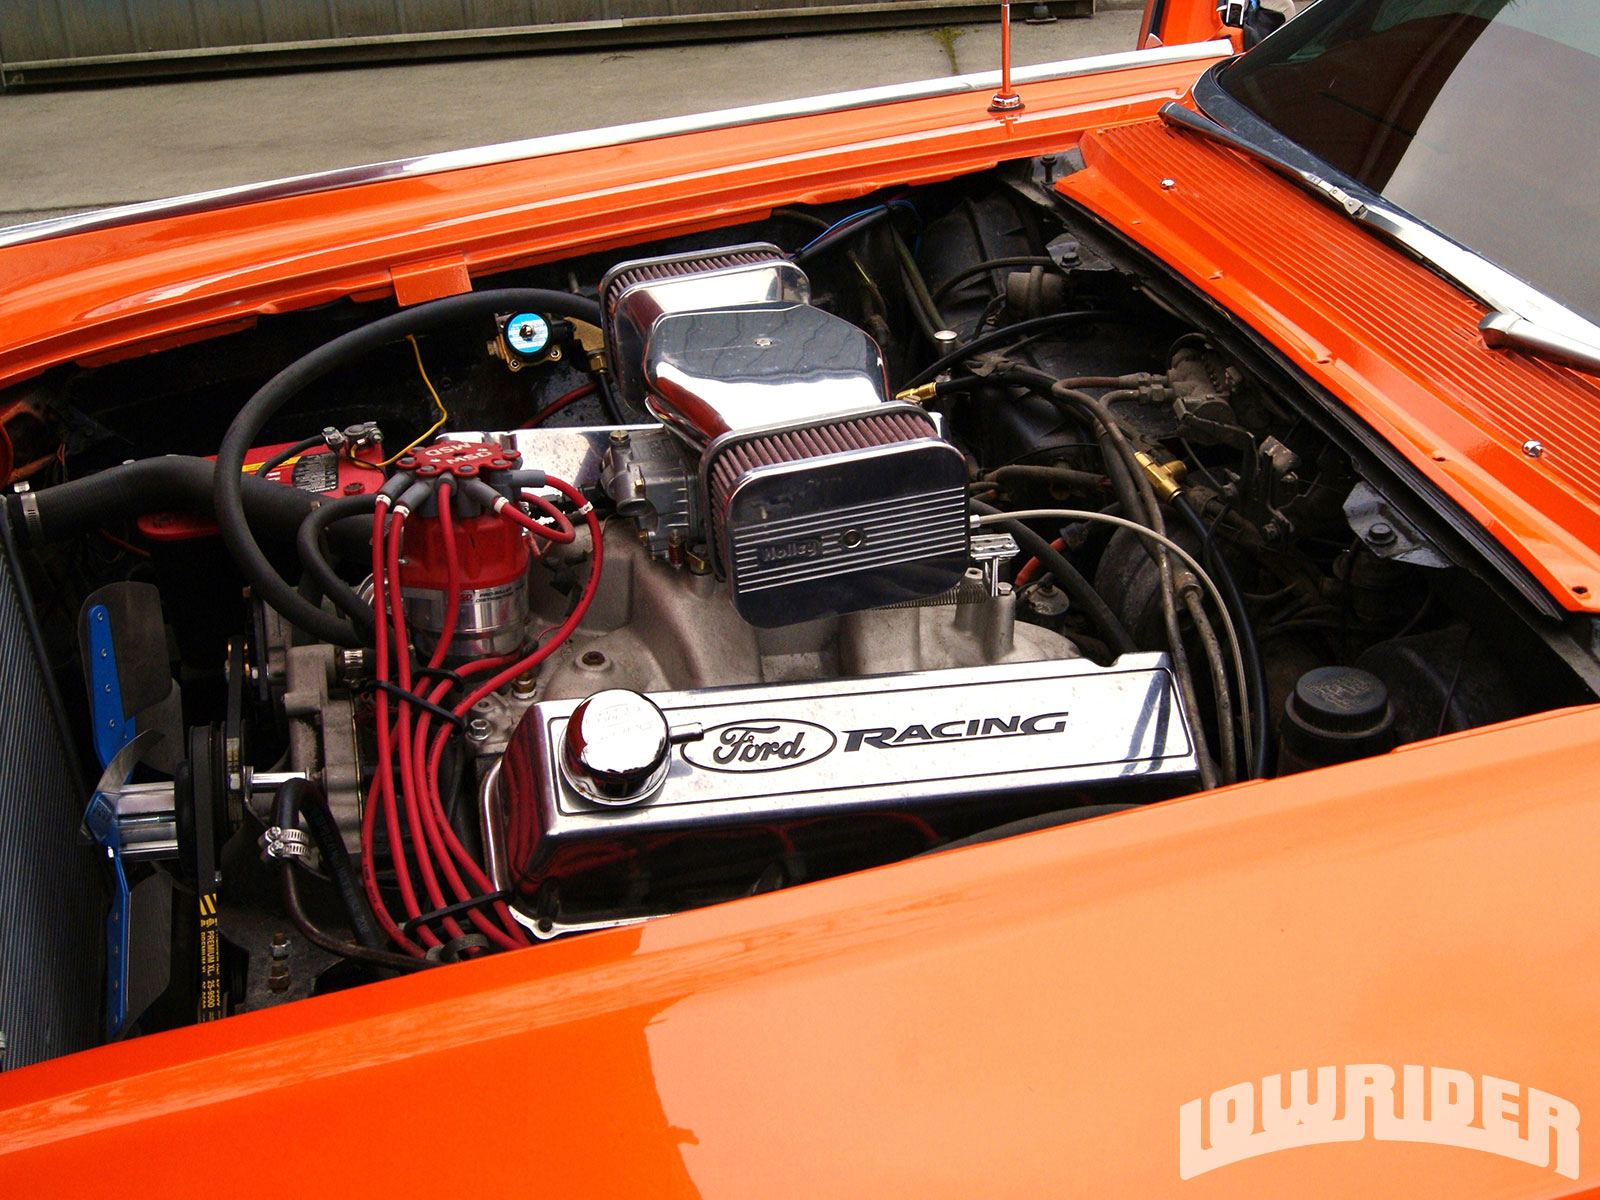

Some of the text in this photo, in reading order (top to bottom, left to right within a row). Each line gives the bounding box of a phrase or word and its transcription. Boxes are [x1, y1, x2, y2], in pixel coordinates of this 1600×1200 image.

[425, 443, 471, 456] MSD
[445, 451, 493, 464] MSD
[713, 711, 1069, 764] Ford RACING
[206, 930, 215, 963] PREMIUM
[206, 980, 215, 1008] 25-9500
